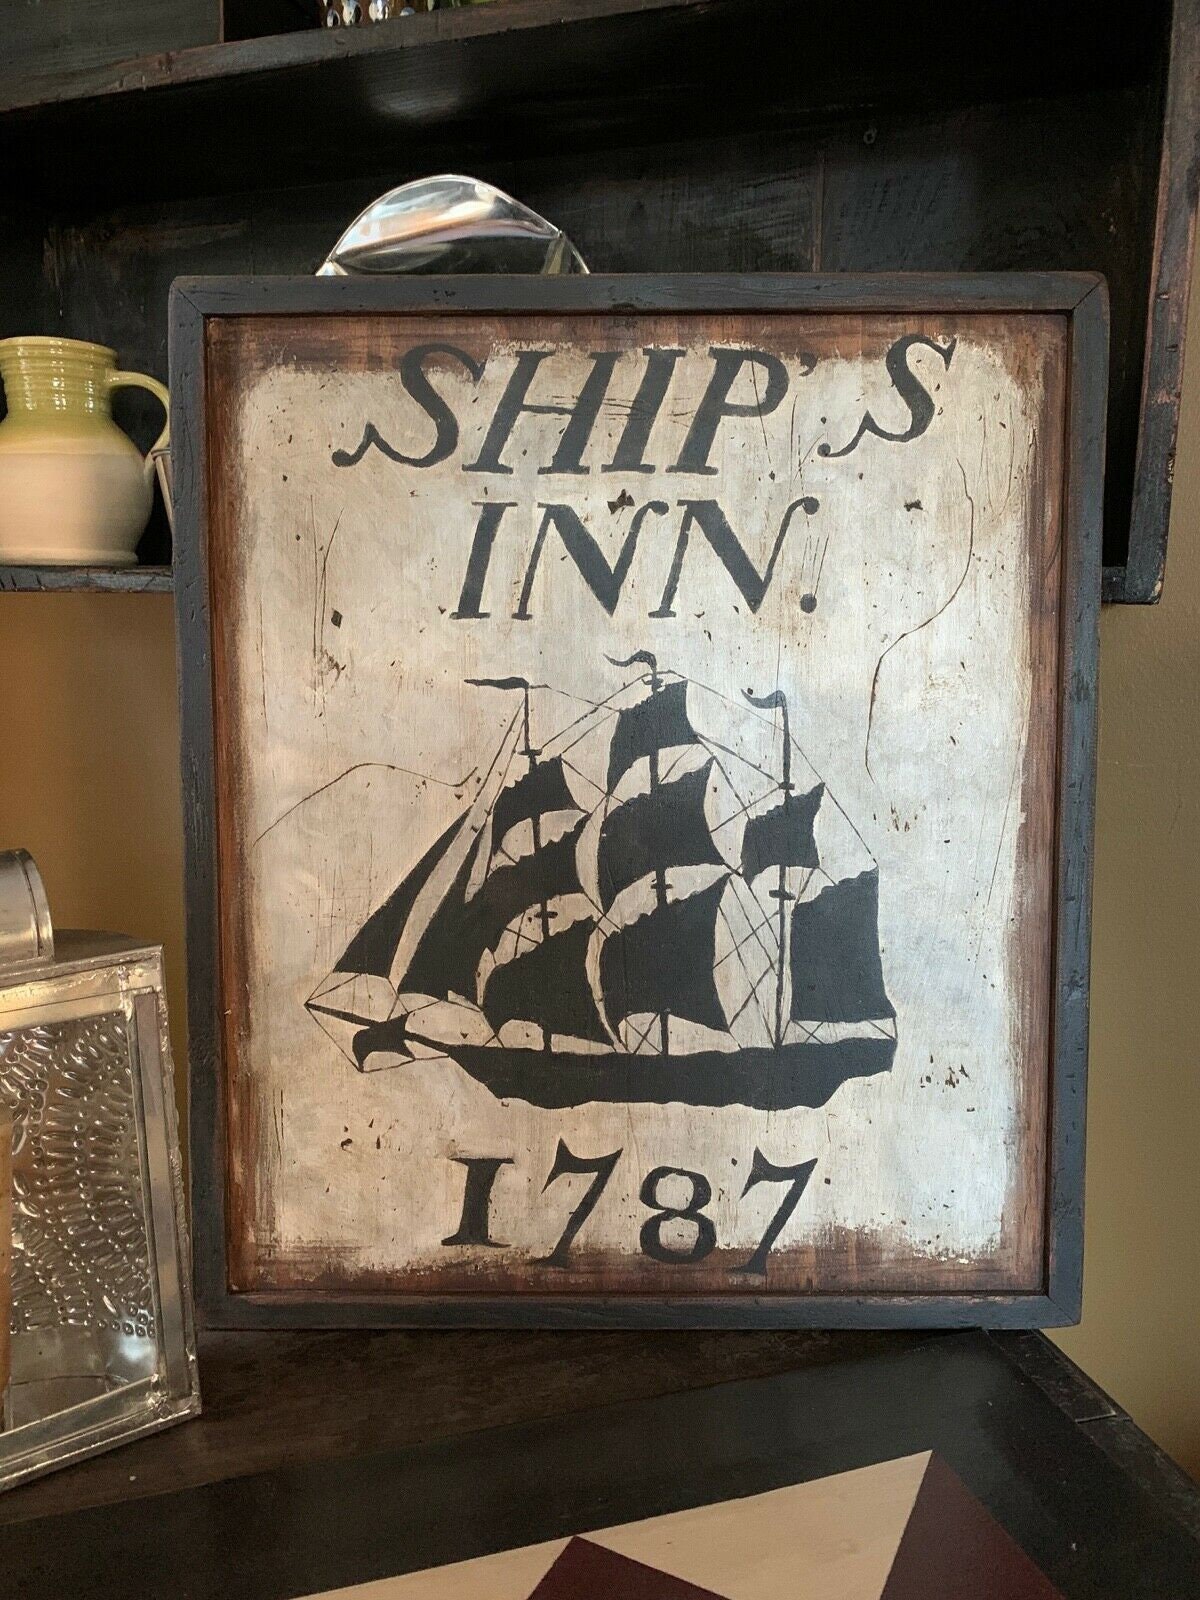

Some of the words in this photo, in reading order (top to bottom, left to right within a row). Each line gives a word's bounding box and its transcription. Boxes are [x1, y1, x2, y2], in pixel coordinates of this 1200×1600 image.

[331, 334, 957, 475] SHIP'S
[449, 496, 820, 620] INN.
[441, 1137, 818, 1275] 1787
